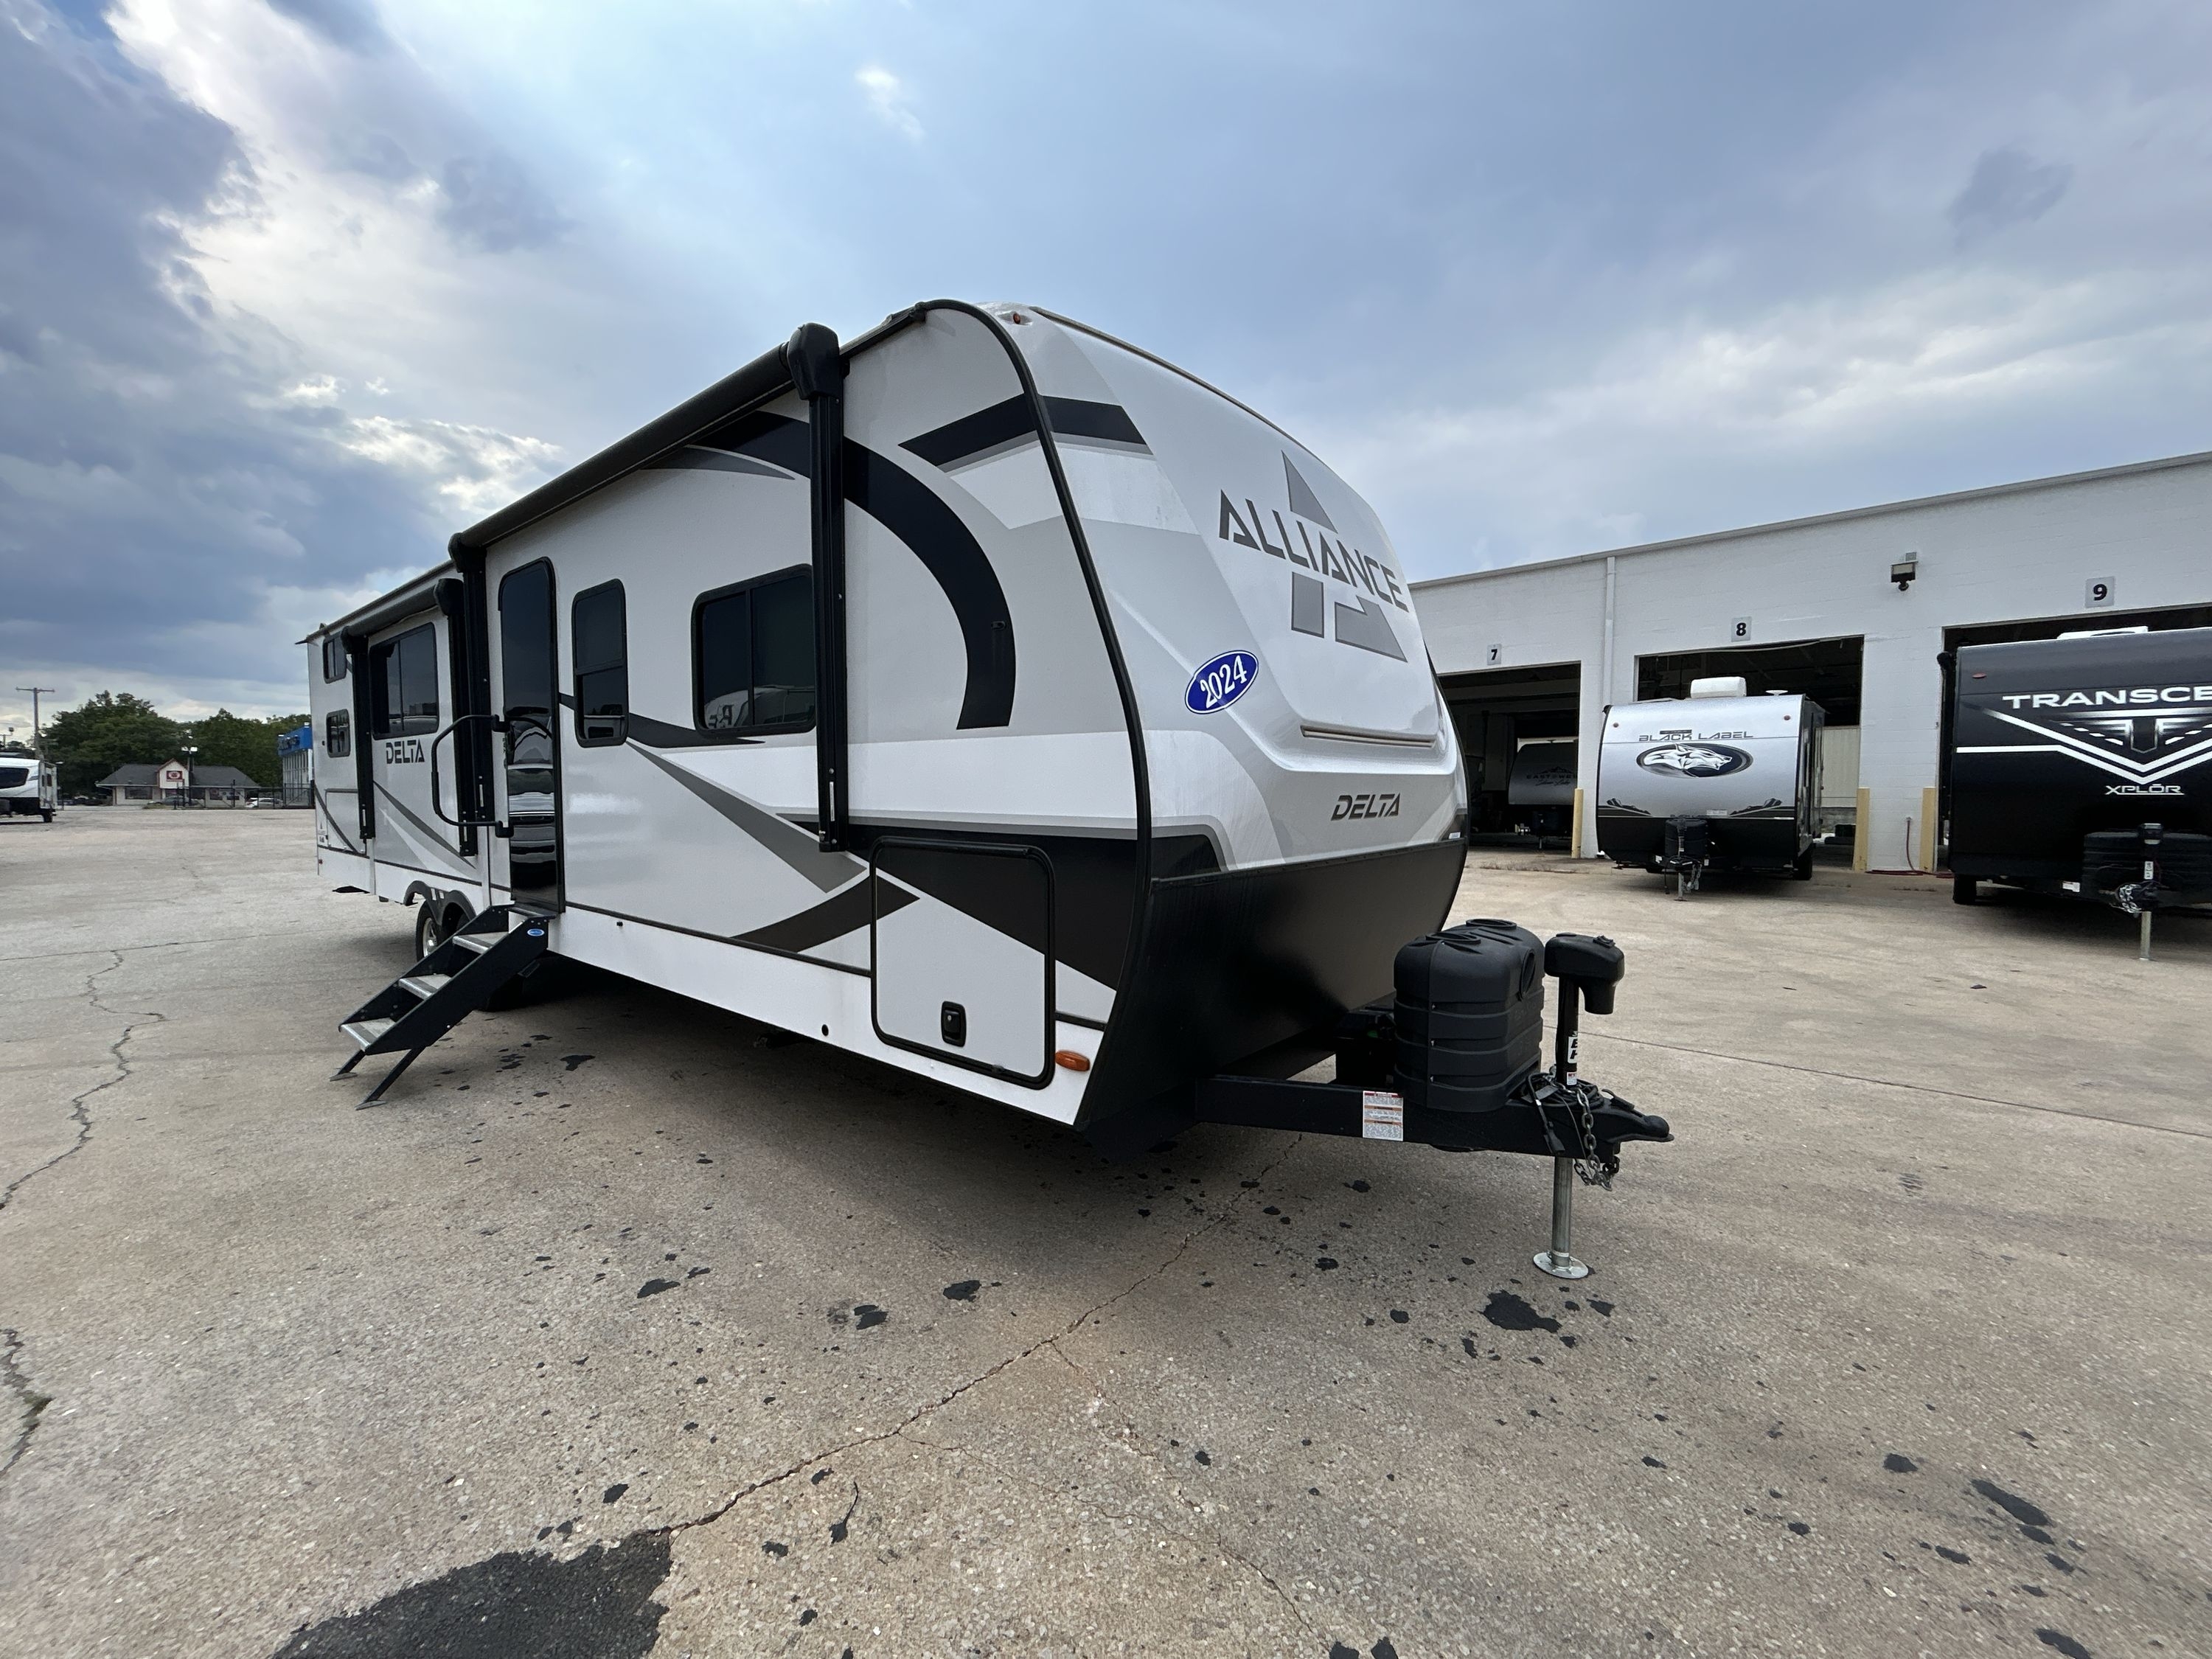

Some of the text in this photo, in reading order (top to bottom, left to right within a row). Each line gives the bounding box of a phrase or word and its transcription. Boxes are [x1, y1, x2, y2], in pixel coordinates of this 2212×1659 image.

[1219, 489, 1409, 613] ALLIANCE
[2093, 583, 2108, 601] 9
[1736, 622, 1747, 636] 8
[1490, 648, 1498, 661] 7
[1200, 655, 1248, 709] 2024
[2002, 686, 2212, 709] TRANSCE
[1638, 733, 1692, 742] BLACK
[1698, 731, 1754, 740] LABEL
[386, 739, 425, 764] DELTA
[1331, 792, 1401, 821] DELTA
